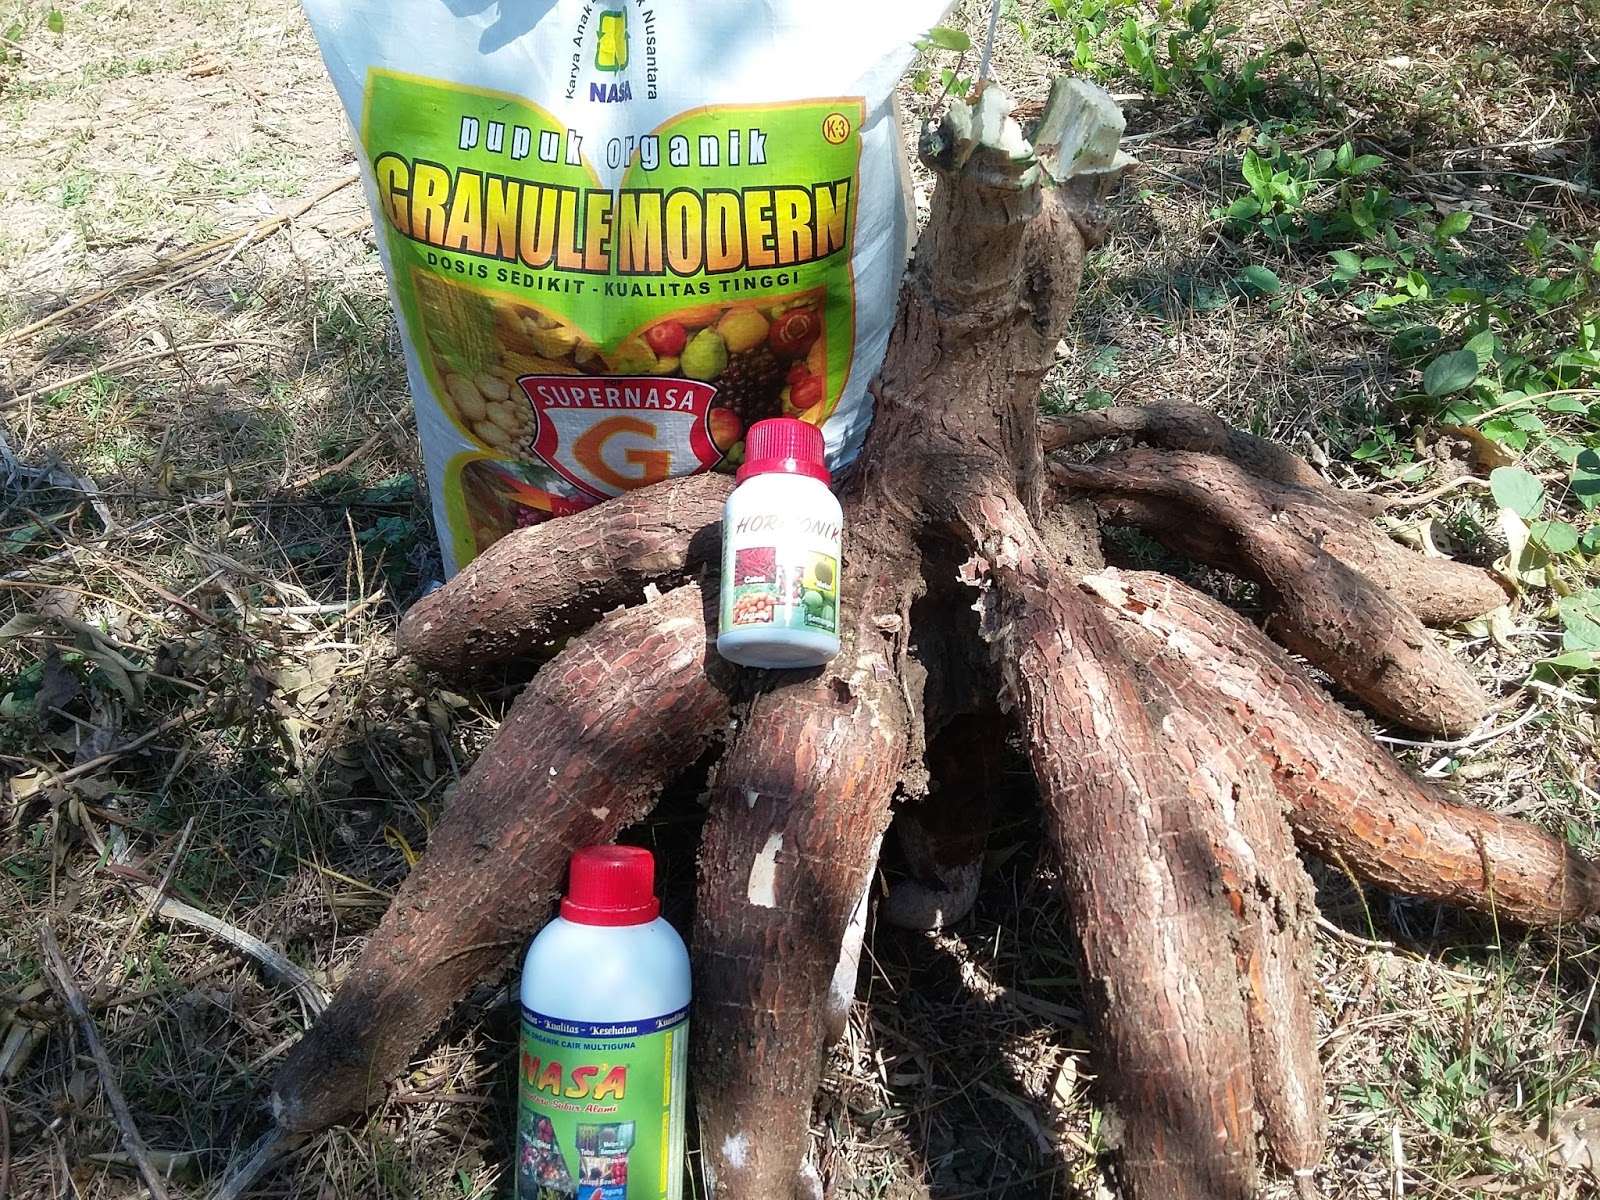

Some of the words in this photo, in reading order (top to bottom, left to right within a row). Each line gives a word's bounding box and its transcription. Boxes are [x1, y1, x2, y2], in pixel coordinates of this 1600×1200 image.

[565, 53, 580, 99] Karya
[573, 4, 592, 48] Anak
[642, 9, 658, 100] Nusantara
[590, 80, 632, 103] NASA
[459, 115, 583, 167] pupuk
[606, 128, 768, 171] organik
[374, 151, 613, 275] GRANULE
[616, 176, 851, 277] MODERN
[427, 252, 488, 279] DOSIS
[497, 268, 585, 294] SEDIKIT
[604, 281, 711, 297] KUALITAS
[719, 271, 799, 292] TINGGI
[537, 385, 695, 411] SUPERNASA
[571, 415, 672, 491] G
[736, 514, 840, 544] HORONIK
[544, 1020, 579, 1033] Kualitas
[589, 1025, 638, 1036] Kesehatan
[561, 1040, 581, 1050] CAIR
[583, 1042, 636, 1051] MULTIGUNA
[521, 1050, 627, 1100] NASA
[552, 1100, 580, 1112] Subur
[584, 1104, 618, 1113] Alami
